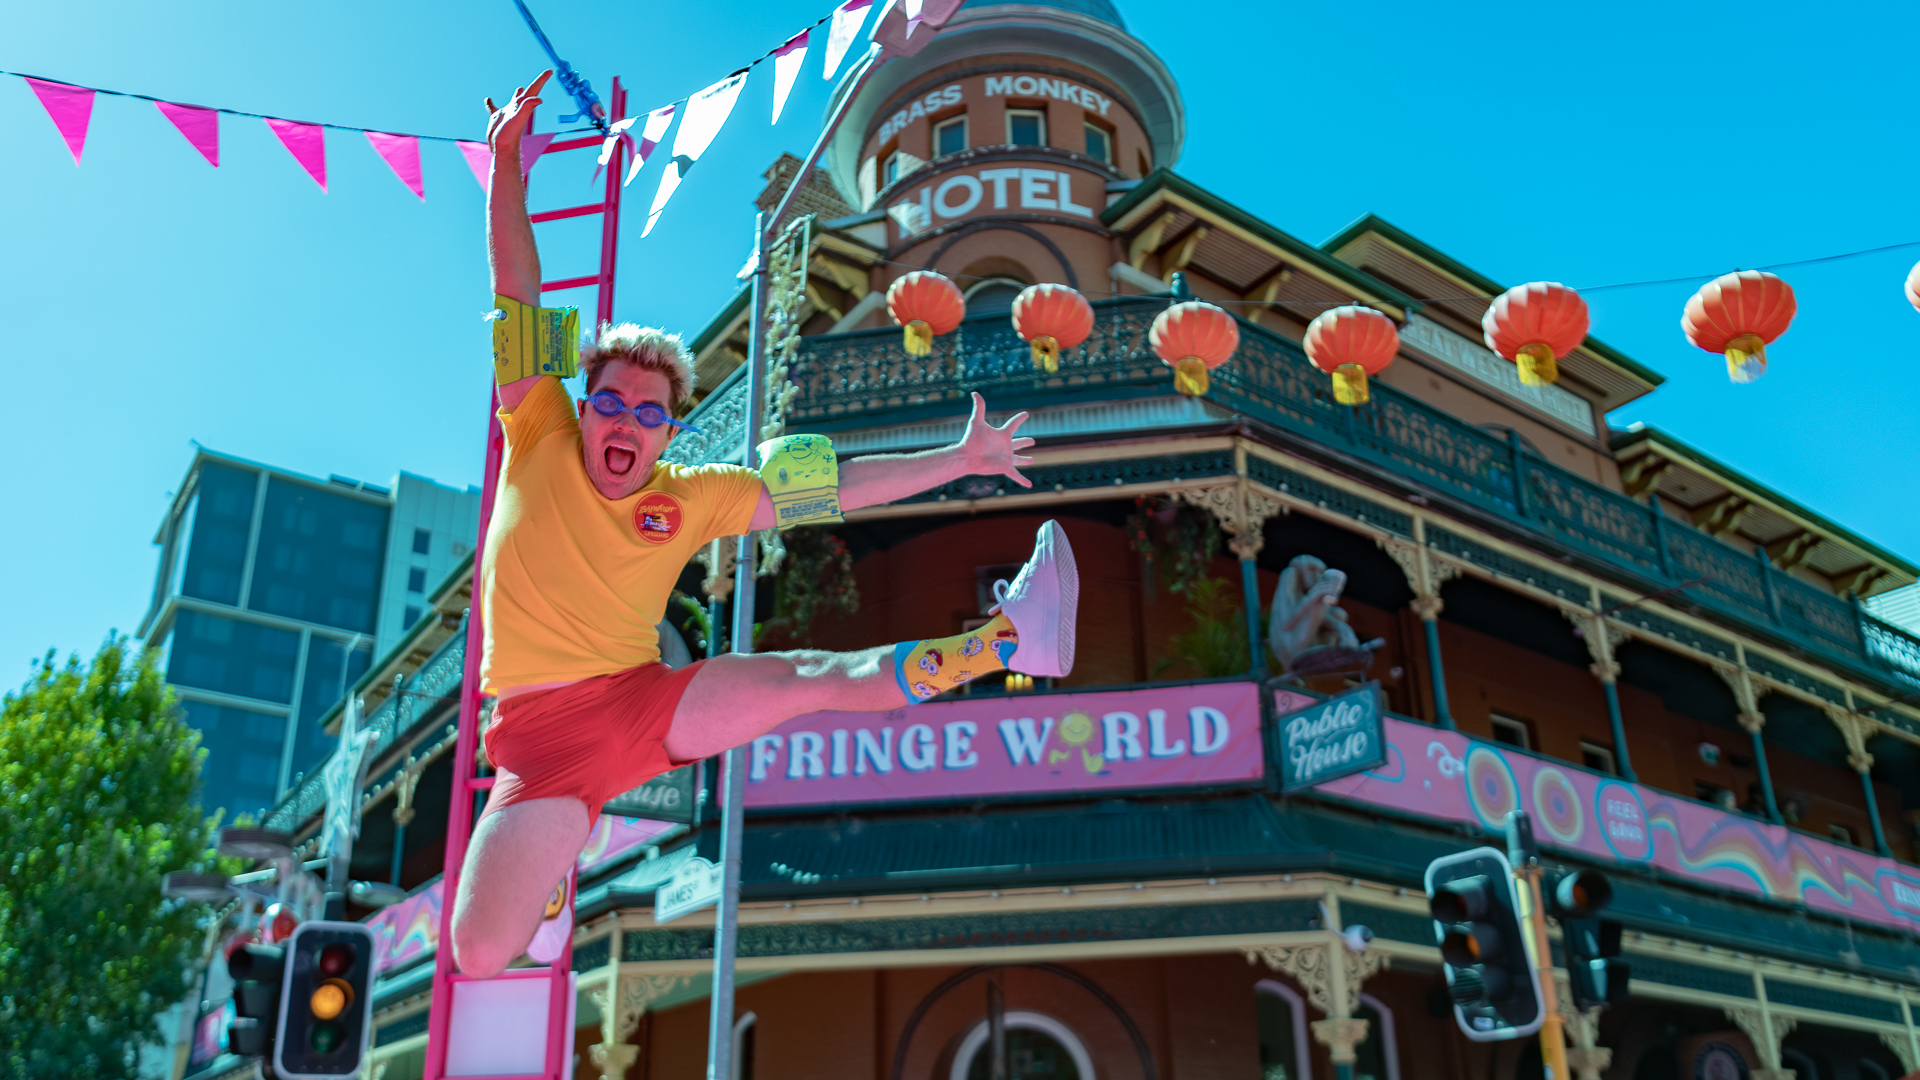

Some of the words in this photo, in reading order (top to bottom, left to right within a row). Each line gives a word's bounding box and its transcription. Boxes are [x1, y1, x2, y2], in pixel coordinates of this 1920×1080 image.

[878, 84, 963, 146] BRASS
[985, 75, 1112, 117] MONKEY
[898, 167, 1094, 239] HOTEL
[748, 720, 979, 783] FRINGE
[1285, 700, 1364, 749] Public
[1290, 730, 1369, 780] House
